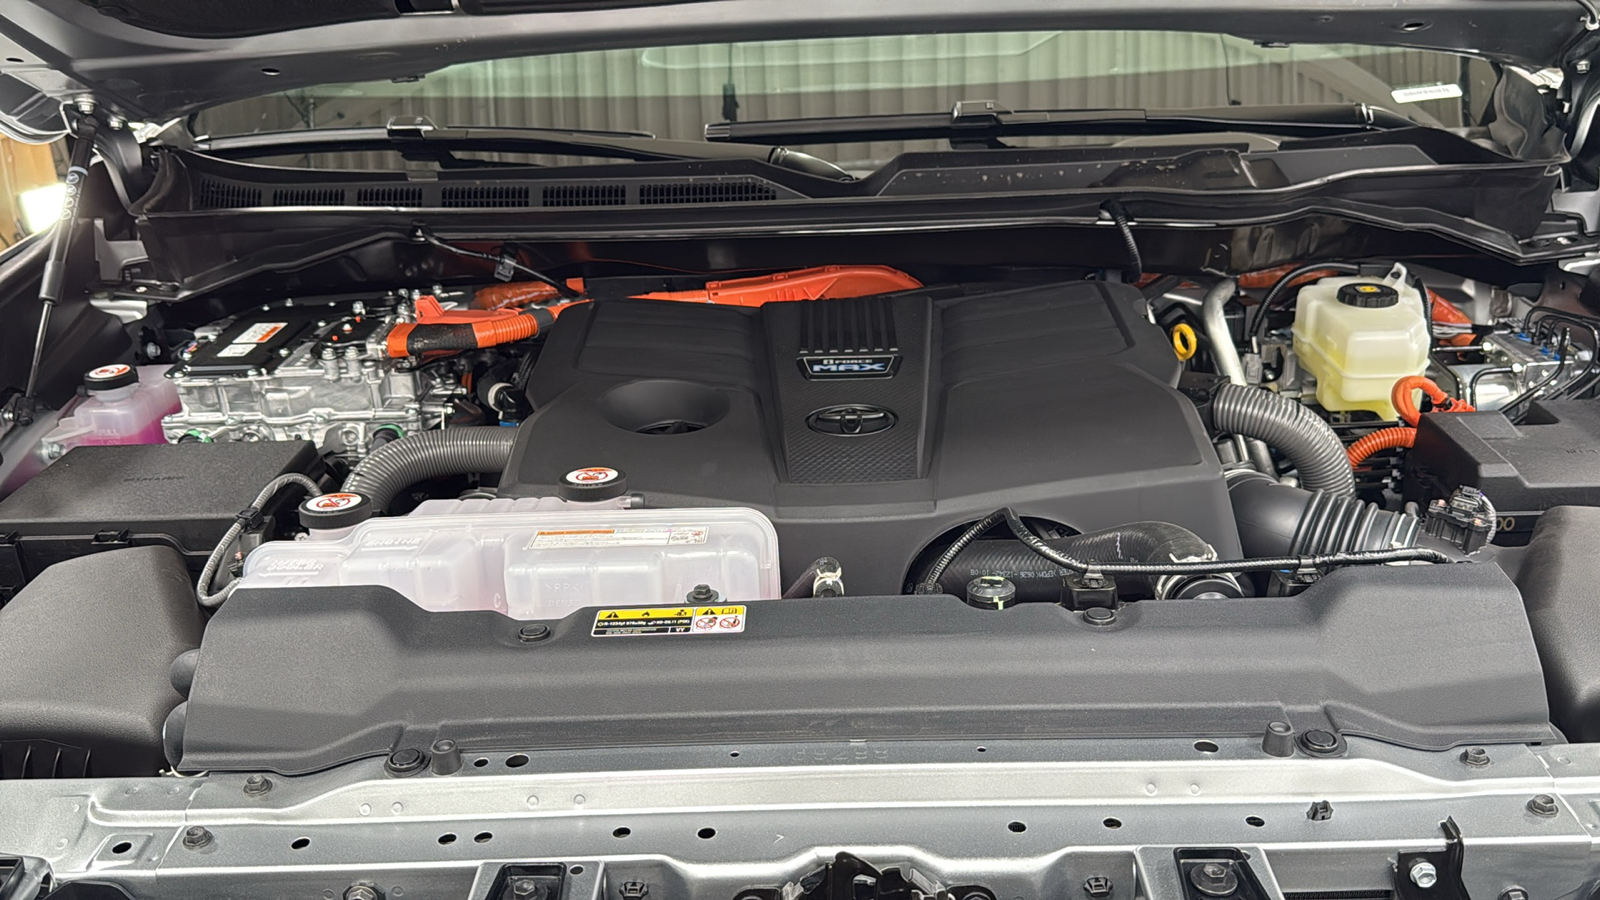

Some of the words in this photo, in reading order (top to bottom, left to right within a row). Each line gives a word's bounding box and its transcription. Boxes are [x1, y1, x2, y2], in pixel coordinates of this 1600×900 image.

[812, 363, 885, 372] MAX
[365, 537, 422, 547] ENGINE
[547, 599, 581, 608] DENSO
